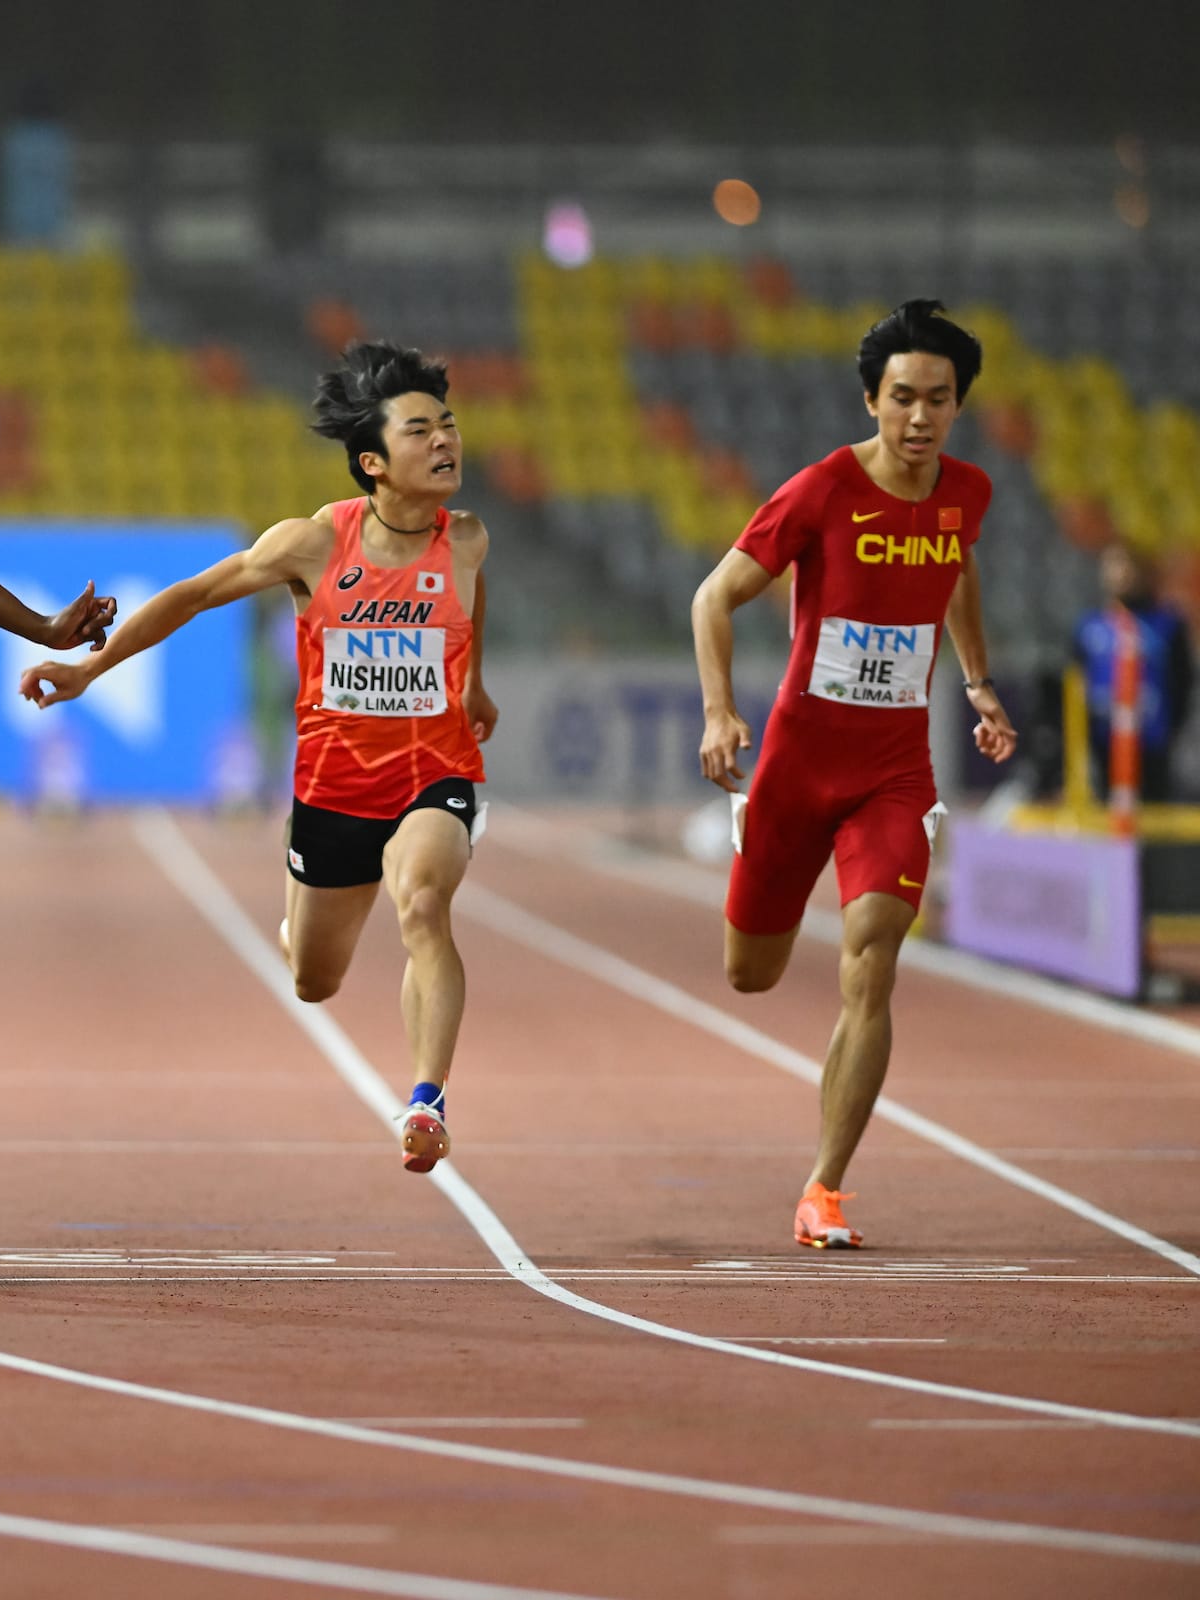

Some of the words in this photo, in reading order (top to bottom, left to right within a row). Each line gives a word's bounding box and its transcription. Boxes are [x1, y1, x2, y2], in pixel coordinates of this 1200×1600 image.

[855, 533, 962, 565] CHINA
[340, 600, 434, 625] JAPAN
[347, 630, 422, 659] NTN
[843, 622, 917, 654] NTN
[330, 662, 439, 692] NISHIOKA
[858, 658, 894, 685] HE
[365, 697, 408, 711] LIMA
[412, 697, 434, 711] 24
[852, 687, 893, 703] LIMA
